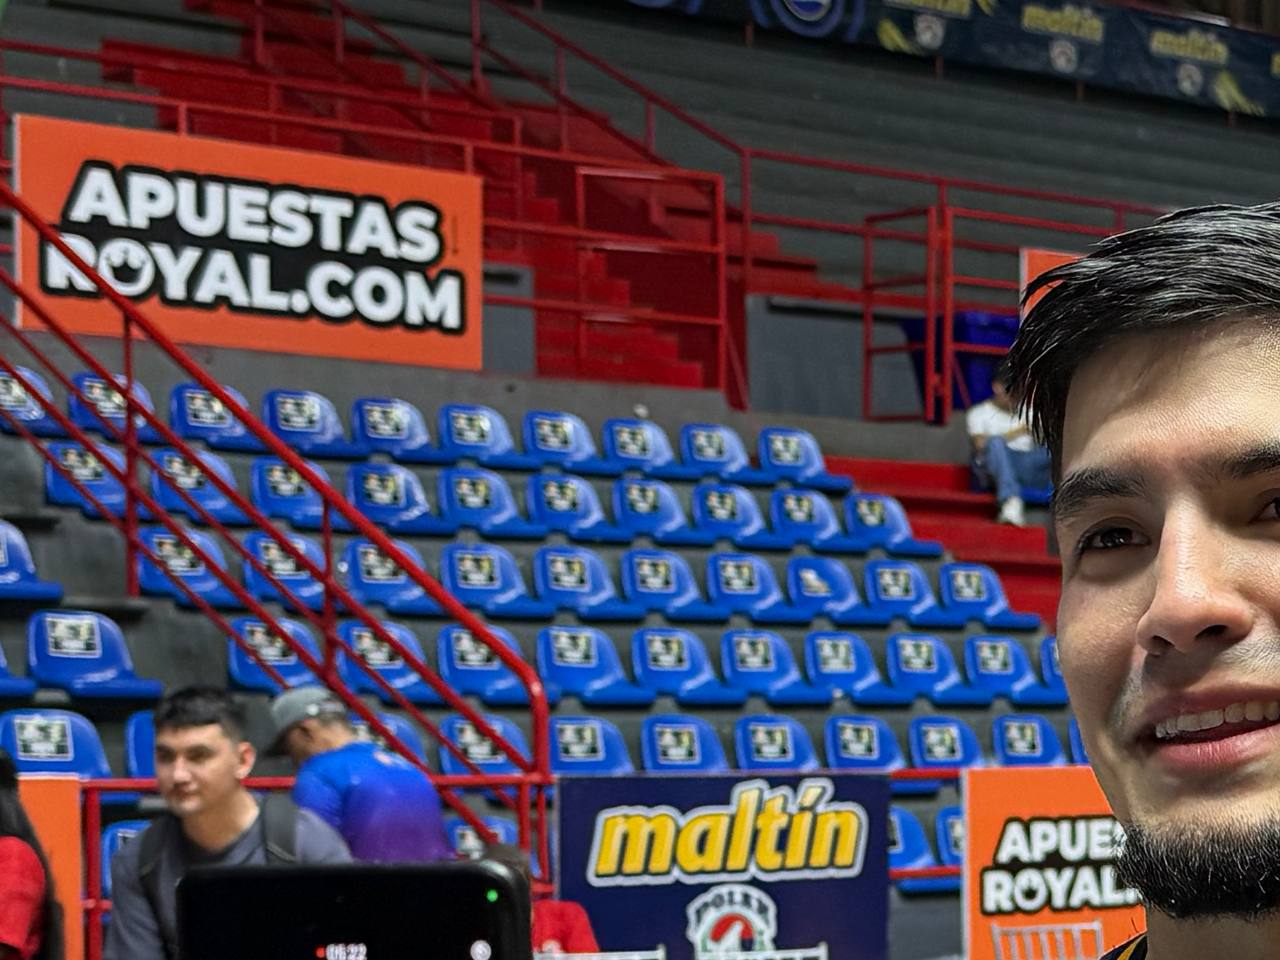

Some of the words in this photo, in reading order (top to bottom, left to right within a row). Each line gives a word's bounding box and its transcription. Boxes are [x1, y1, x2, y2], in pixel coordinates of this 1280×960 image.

[67, 165, 441, 264] APUESTAS
[42, 232, 463, 331] ROYAL.COM
[591, 782, 865, 880] maltín
[982, 862, 1142, 914] ROYAL.
